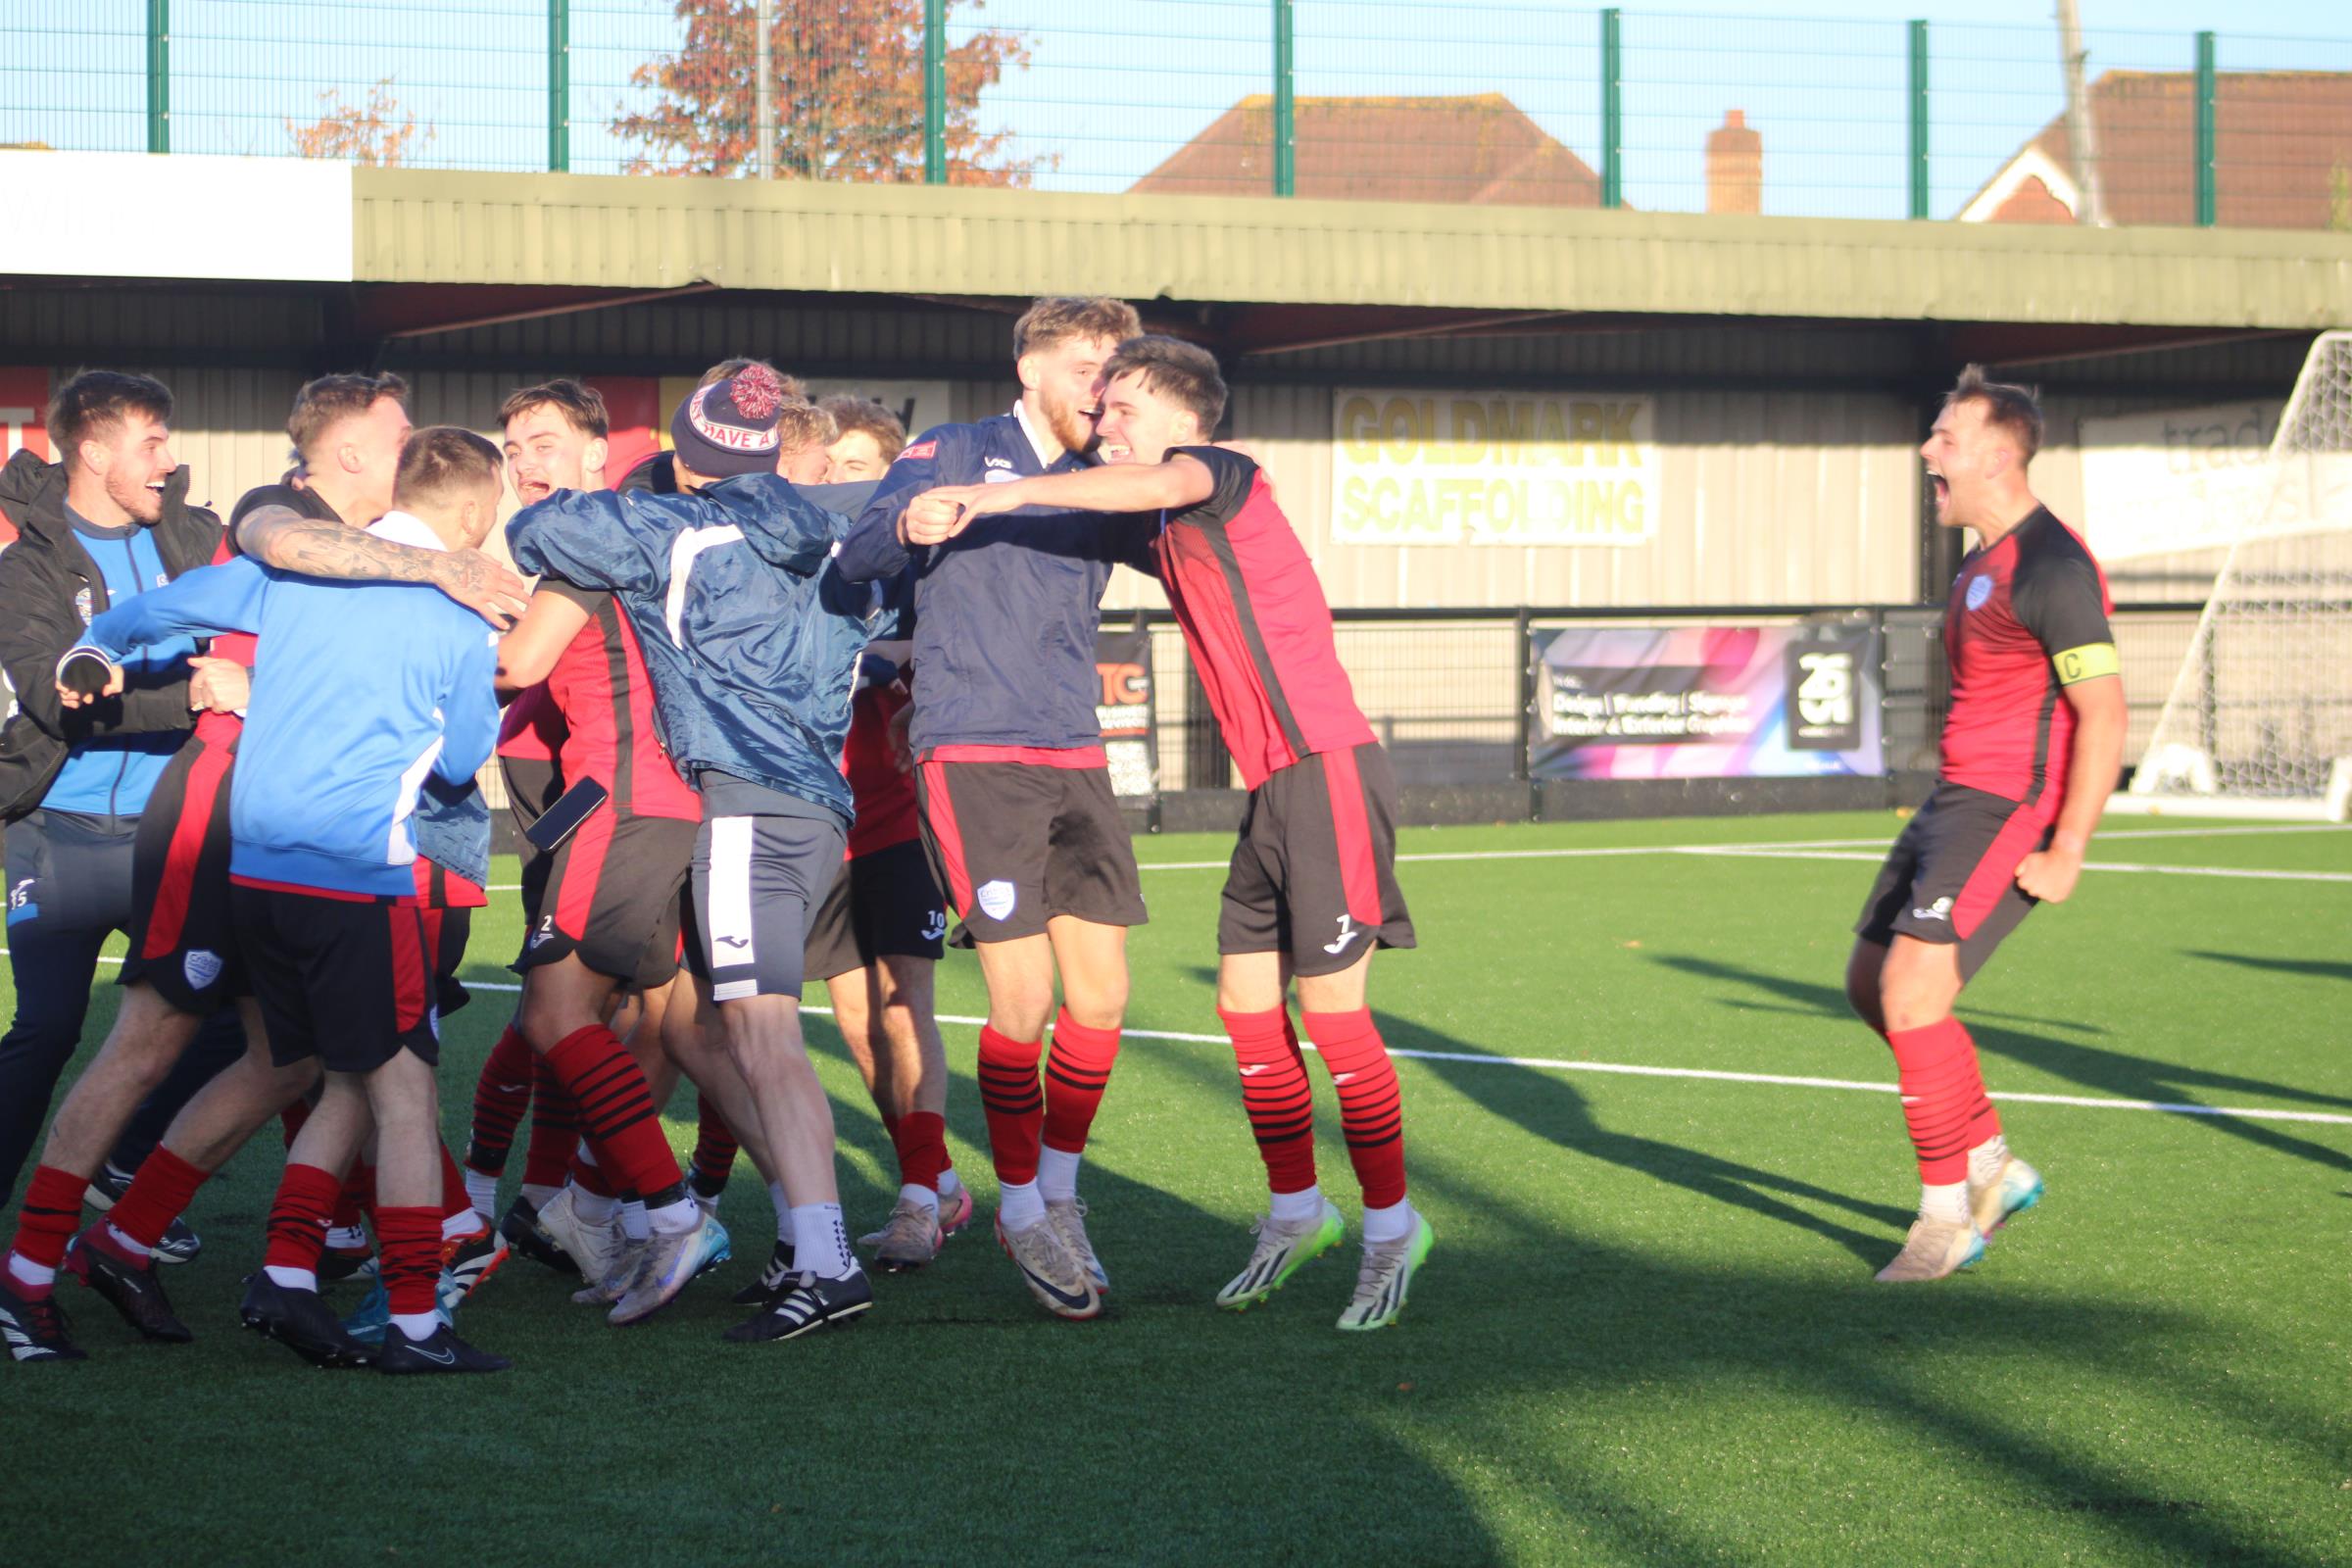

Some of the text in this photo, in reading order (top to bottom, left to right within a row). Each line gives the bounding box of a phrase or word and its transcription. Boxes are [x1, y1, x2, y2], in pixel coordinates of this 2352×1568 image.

[704, 423, 751, 448] HAVE
[1339, 396, 1643, 467] GOLDMARK
[1340, 476, 1644, 533] SCAFFOLDING
[2064, 653, 2082, 679] C
[541, 915, 552, 931] 2
